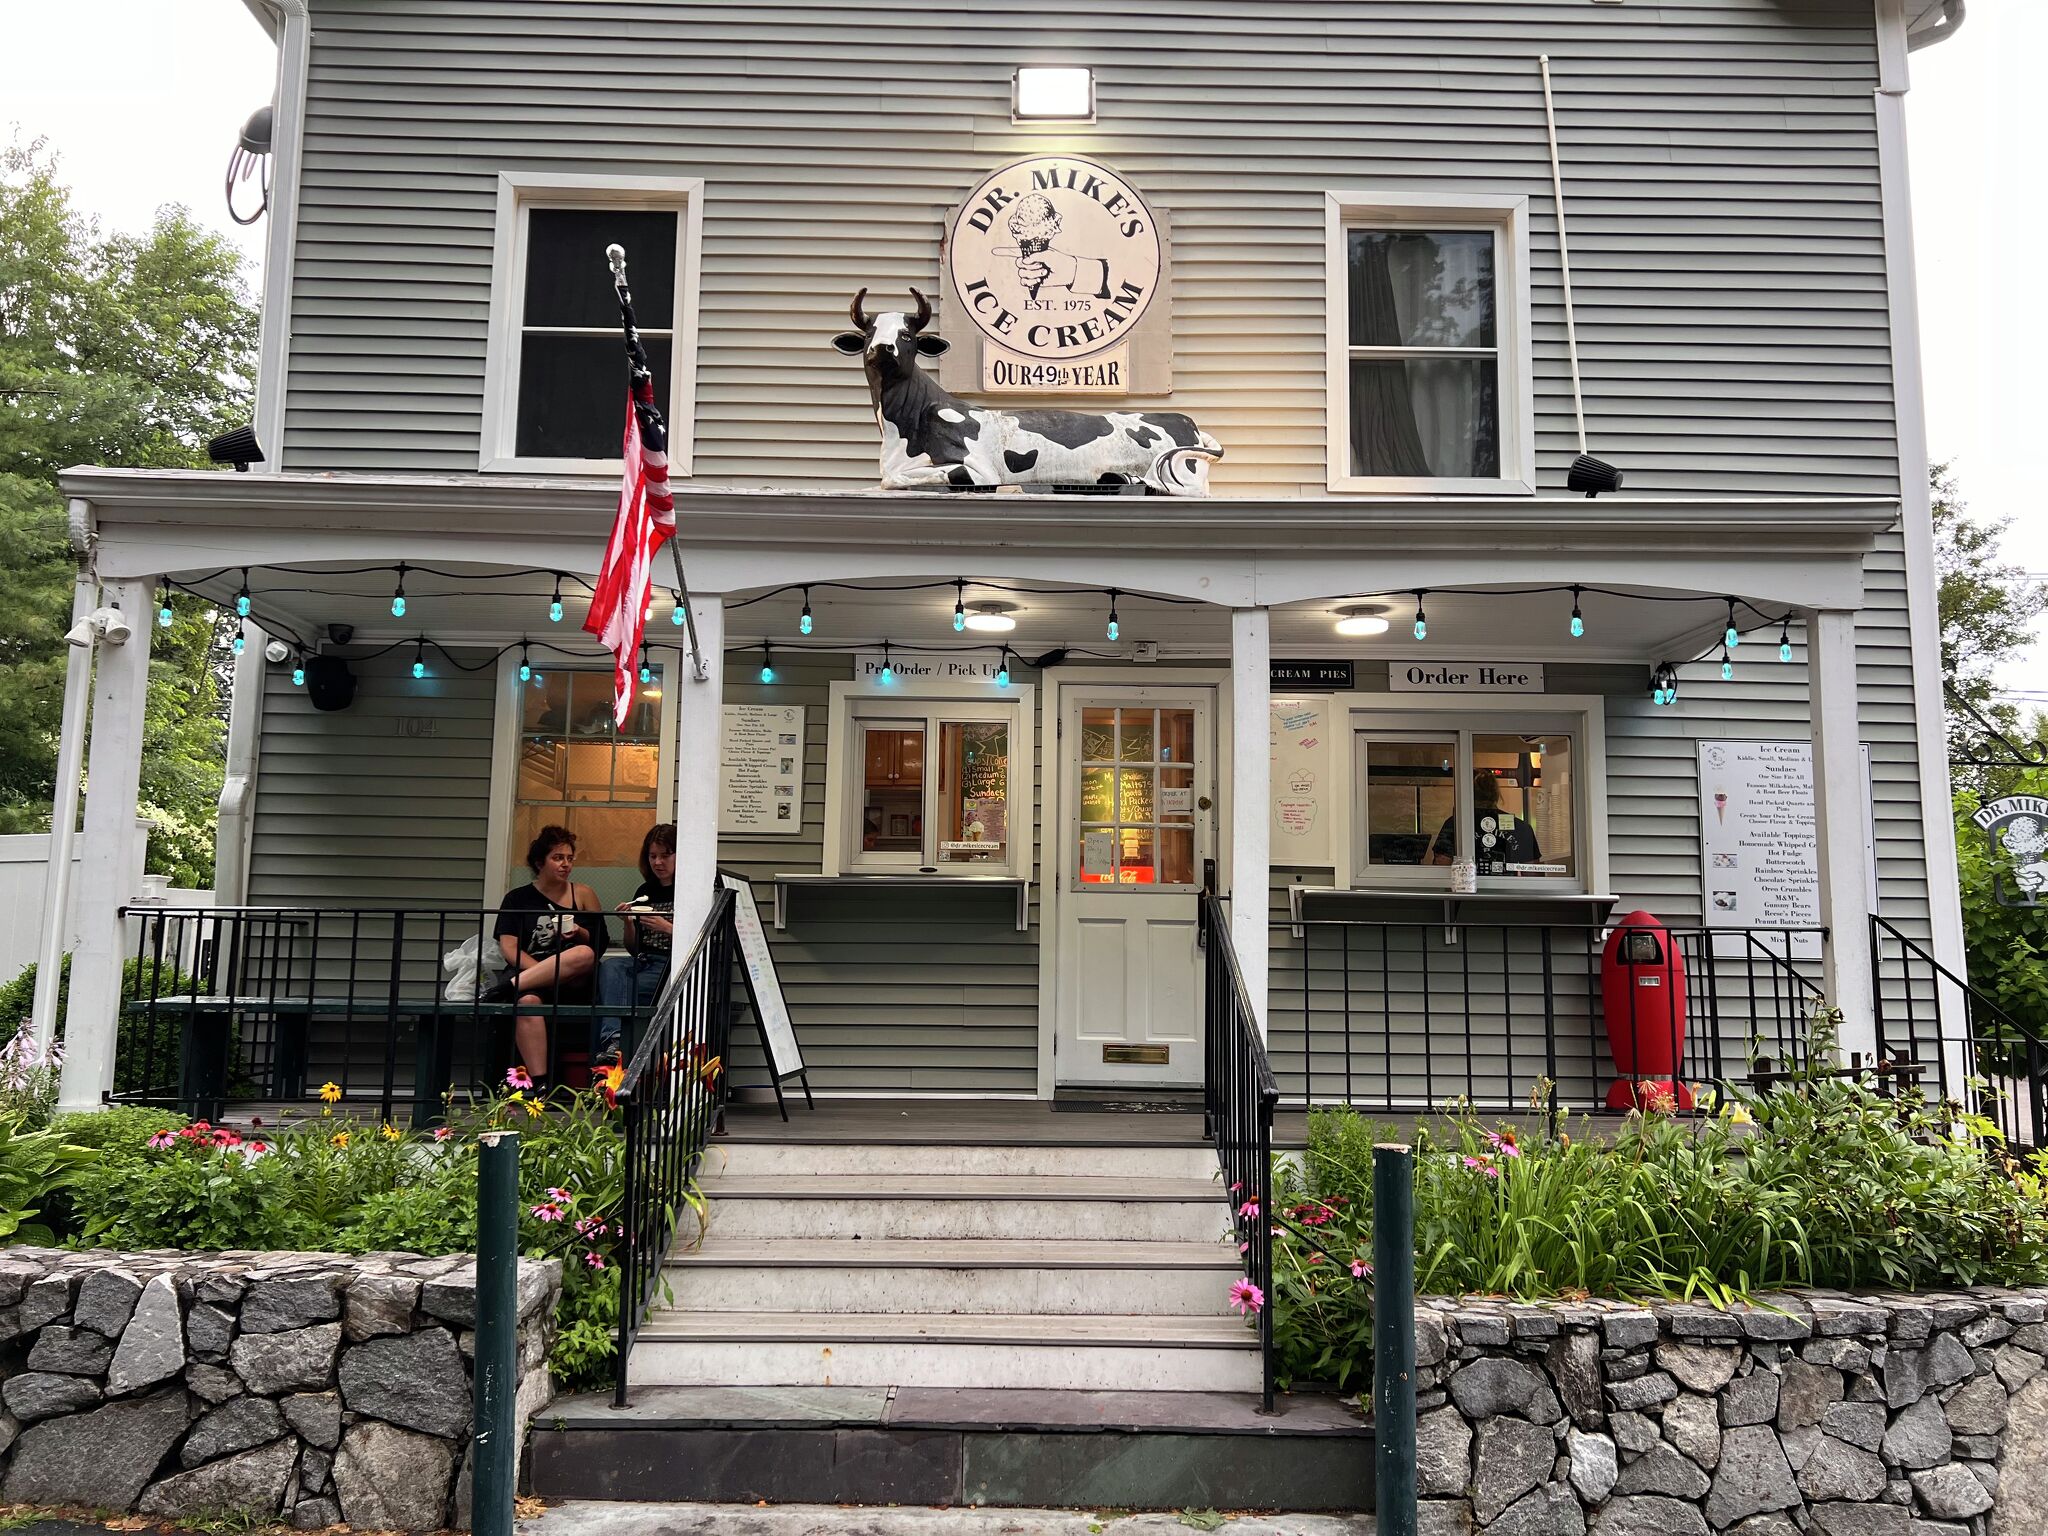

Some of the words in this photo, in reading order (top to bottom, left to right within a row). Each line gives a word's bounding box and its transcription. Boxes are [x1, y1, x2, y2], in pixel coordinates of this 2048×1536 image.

[967, 186, 1020, 235] DR.
[1031, 168, 1144, 239] MIKE'S
[964, 277, 1018, 335] ICE
[1028, 279, 1144, 349] CREAM
[1024, 300, 1057, 311] EST.
[1064, 300, 1092, 311] 1975
[993, 360, 1032, 385] OUR
[1072, 361, 1120, 385] YEAR
[893, 662, 931, 675] Order
[948, 663, 976, 676] Pick
[983, 663, 1000, 678] Up
[1270, 669, 1311, 678] CREAM
[1320, 670, 1347, 679] PIES
[1407, 667, 1469, 685] Order
[1478, 668, 1528, 685] Here
[393, 719, 440, 737] 104
[972, 779, 996, 788] Large
[970, 787, 1005, 798] Sundaes
[1978, 803, 2008, 824] DR.
[2008, 799, 2048, 816] MIK
[1777, 841, 1806, 849] Whipped
